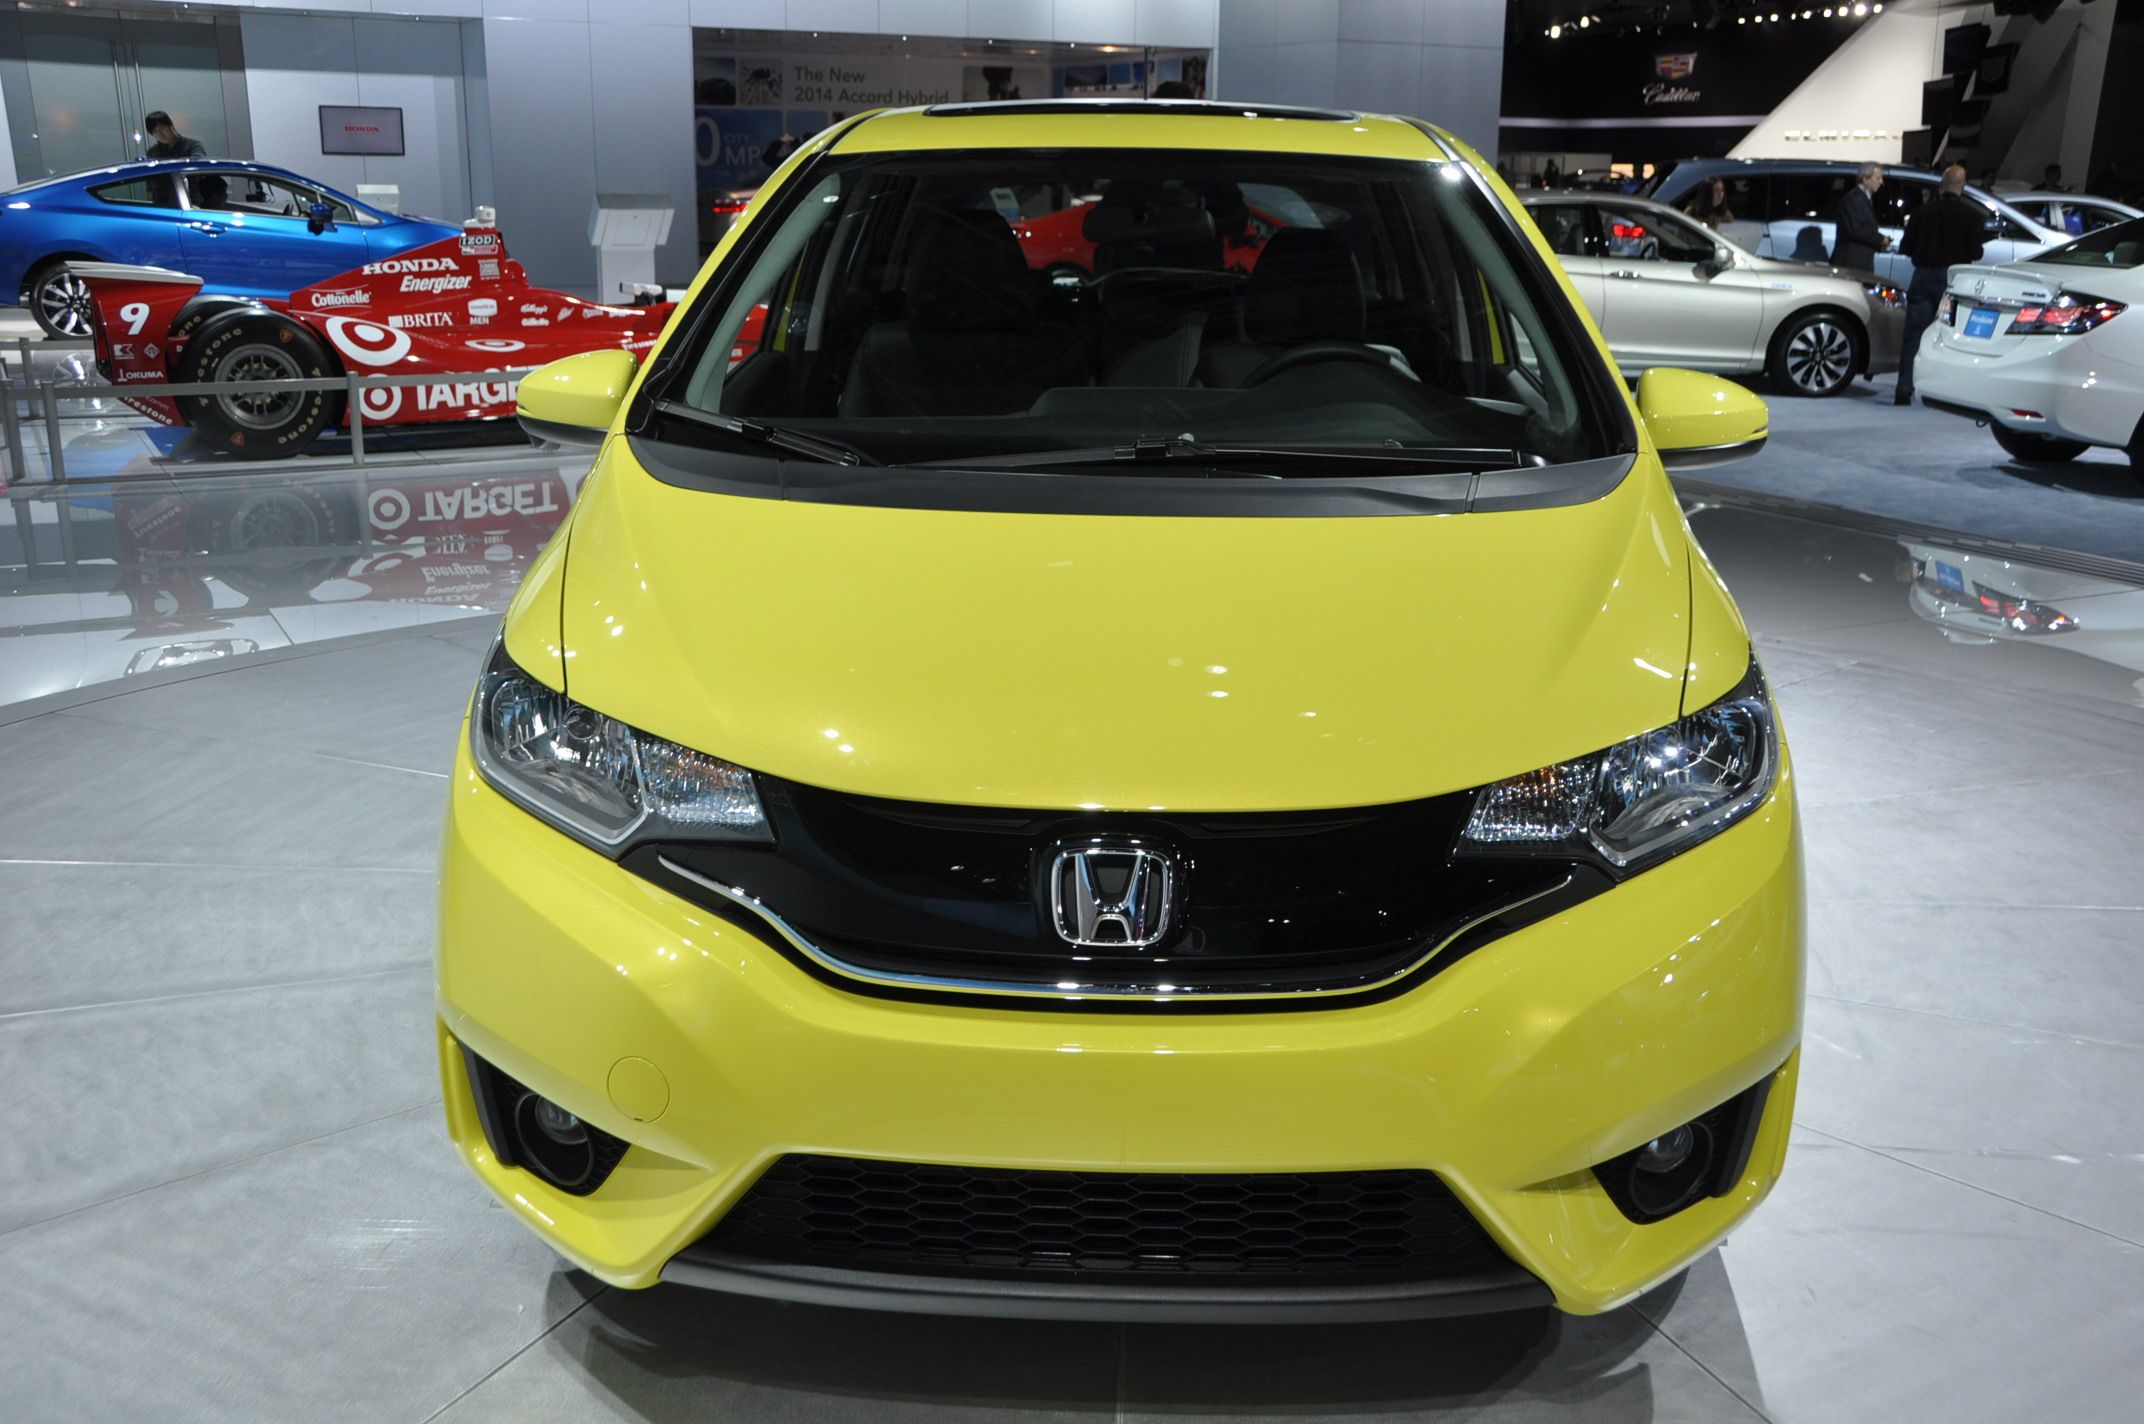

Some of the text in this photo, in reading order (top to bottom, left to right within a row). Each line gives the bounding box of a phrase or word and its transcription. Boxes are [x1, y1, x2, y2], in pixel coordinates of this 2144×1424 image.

[794, 65, 866, 84] The New
[794, 86, 949, 105] 2014 Accord Hybrid
[723, 133, 750, 144] CITY
[726, 145, 764, 167] MP
[461, 235, 492, 246] IZOD
[362, 257, 460, 275] HONDA
[400, 274, 473, 294] Energizer
[311, 289, 371, 307] Cottonelle
[120, 302, 150, 335] 9
[400, 312, 454, 328] BRITA
[469, 317, 490, 326] MEN
